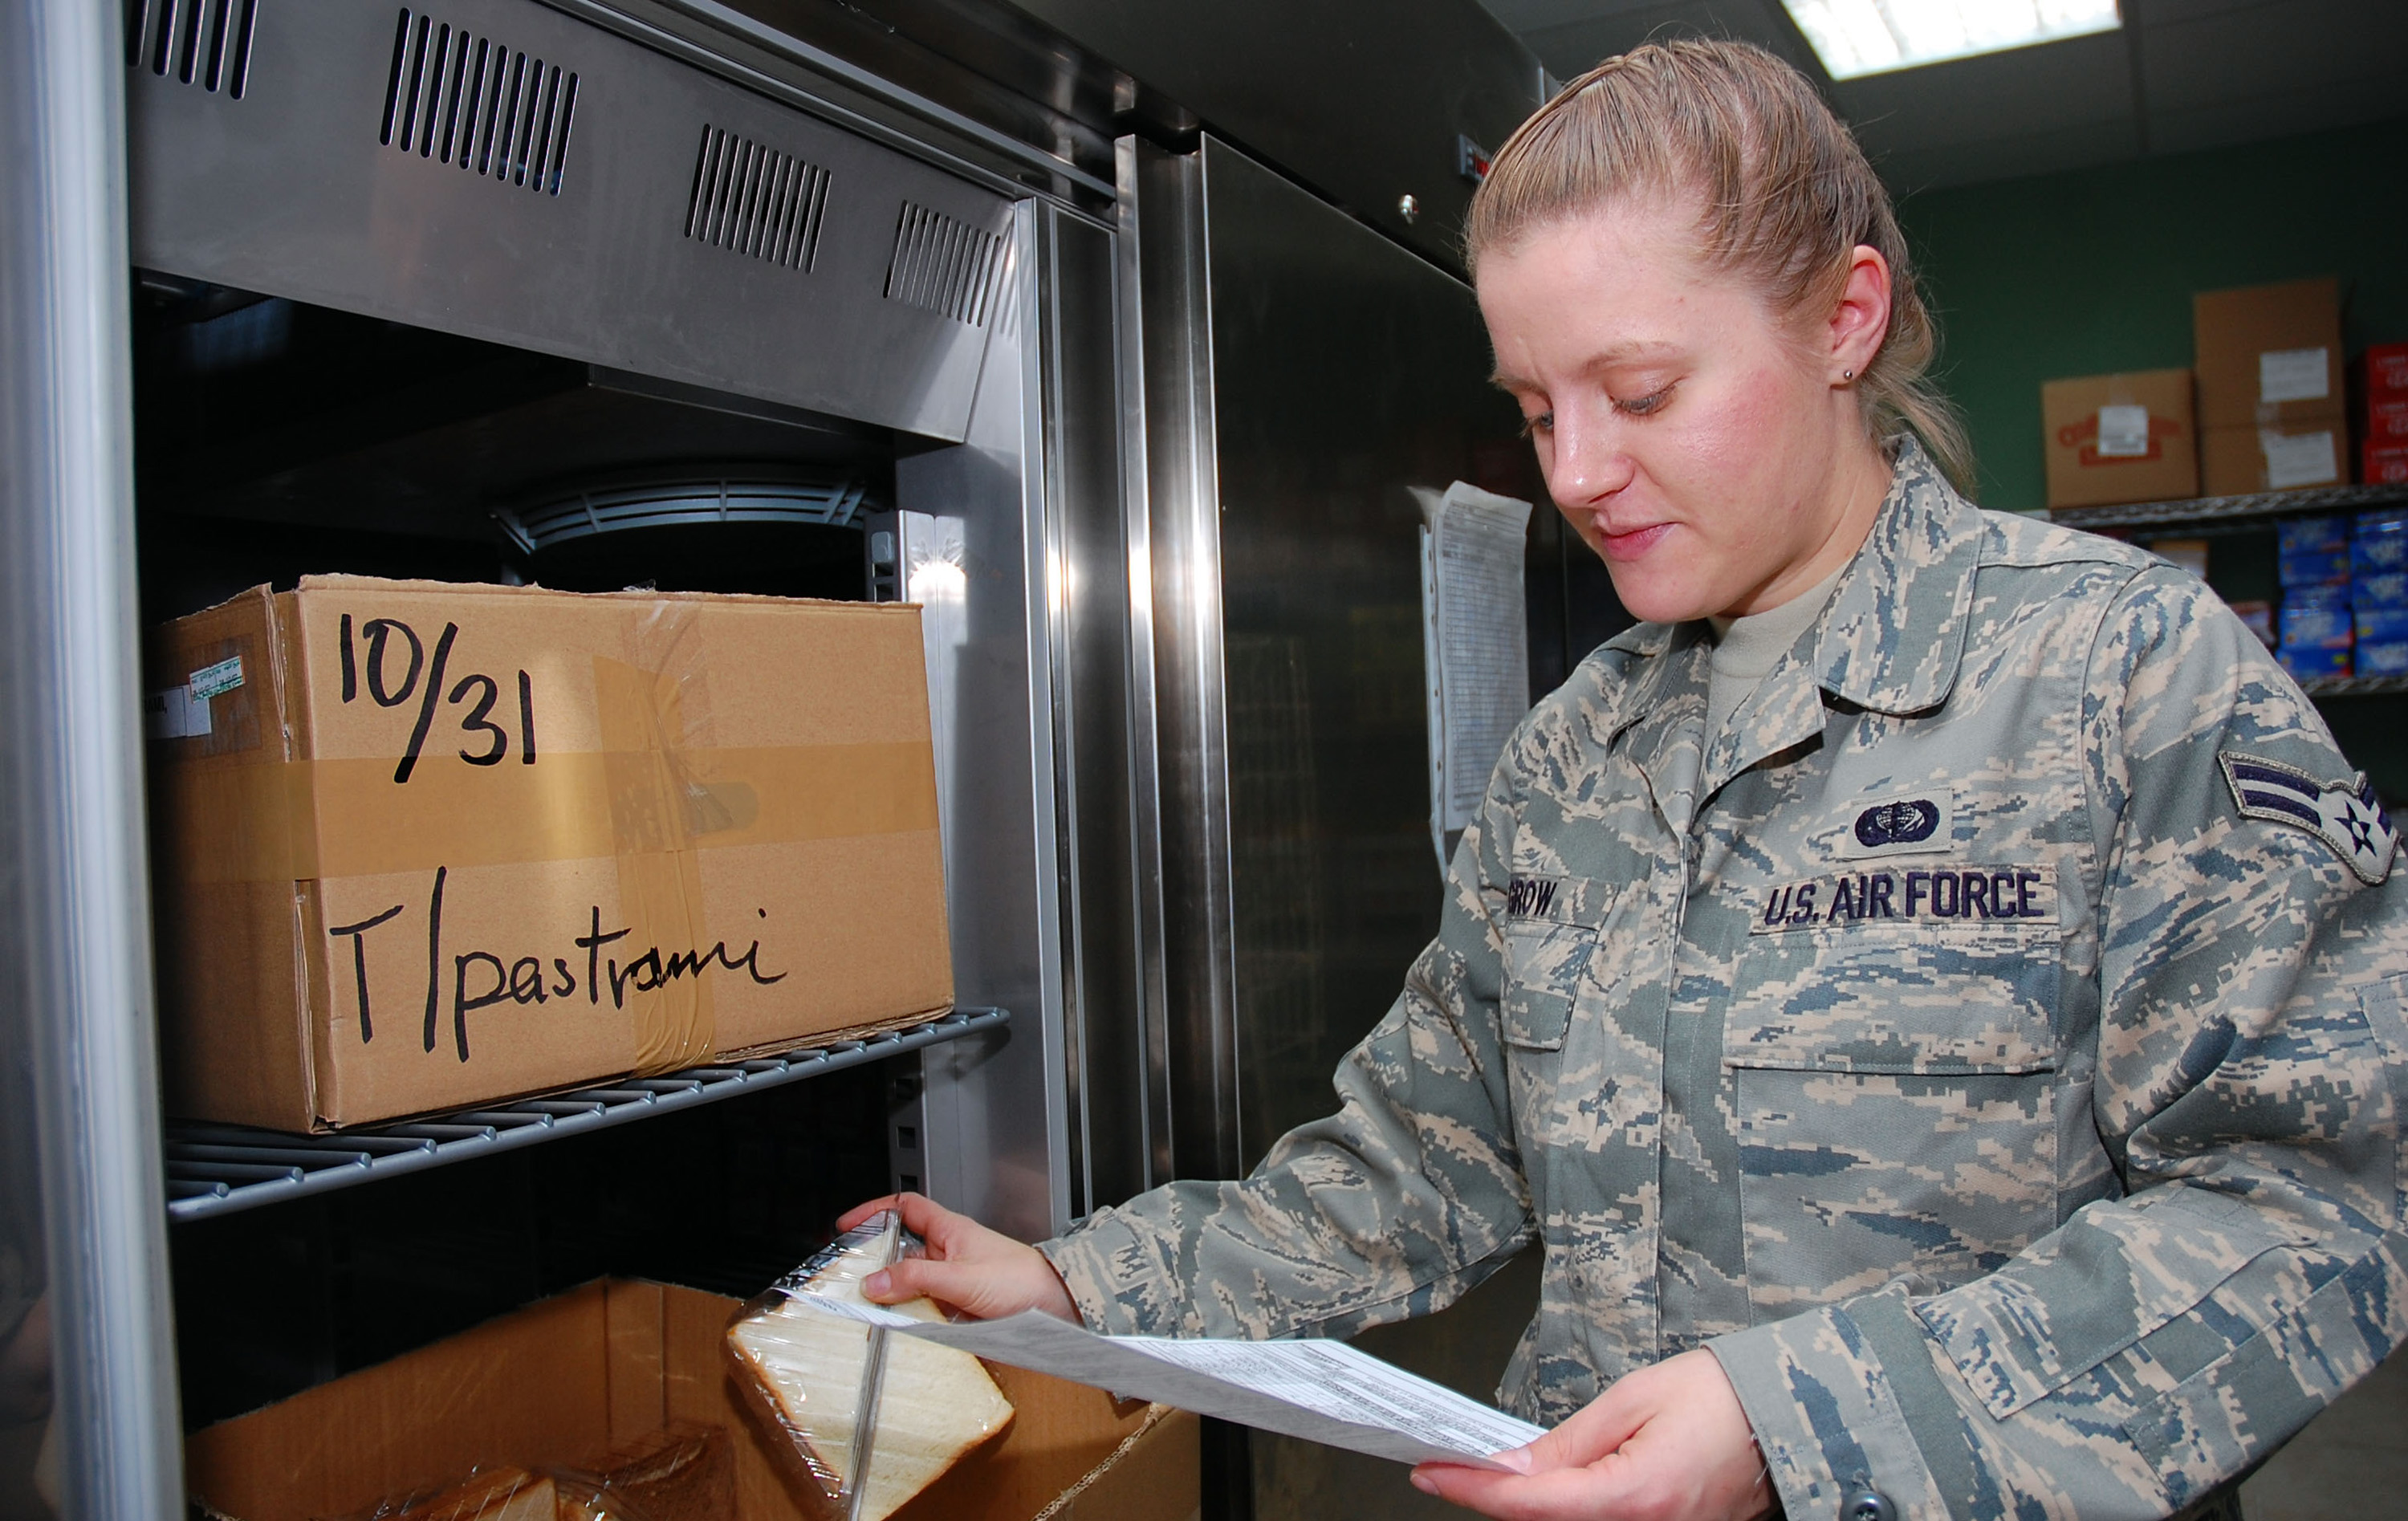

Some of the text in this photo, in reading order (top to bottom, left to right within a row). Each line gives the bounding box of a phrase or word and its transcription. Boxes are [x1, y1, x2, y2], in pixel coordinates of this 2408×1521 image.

[340, 613, 536, 783] 10/31
[1764, 871, 2045, 925] U.S. AIR FORCE
